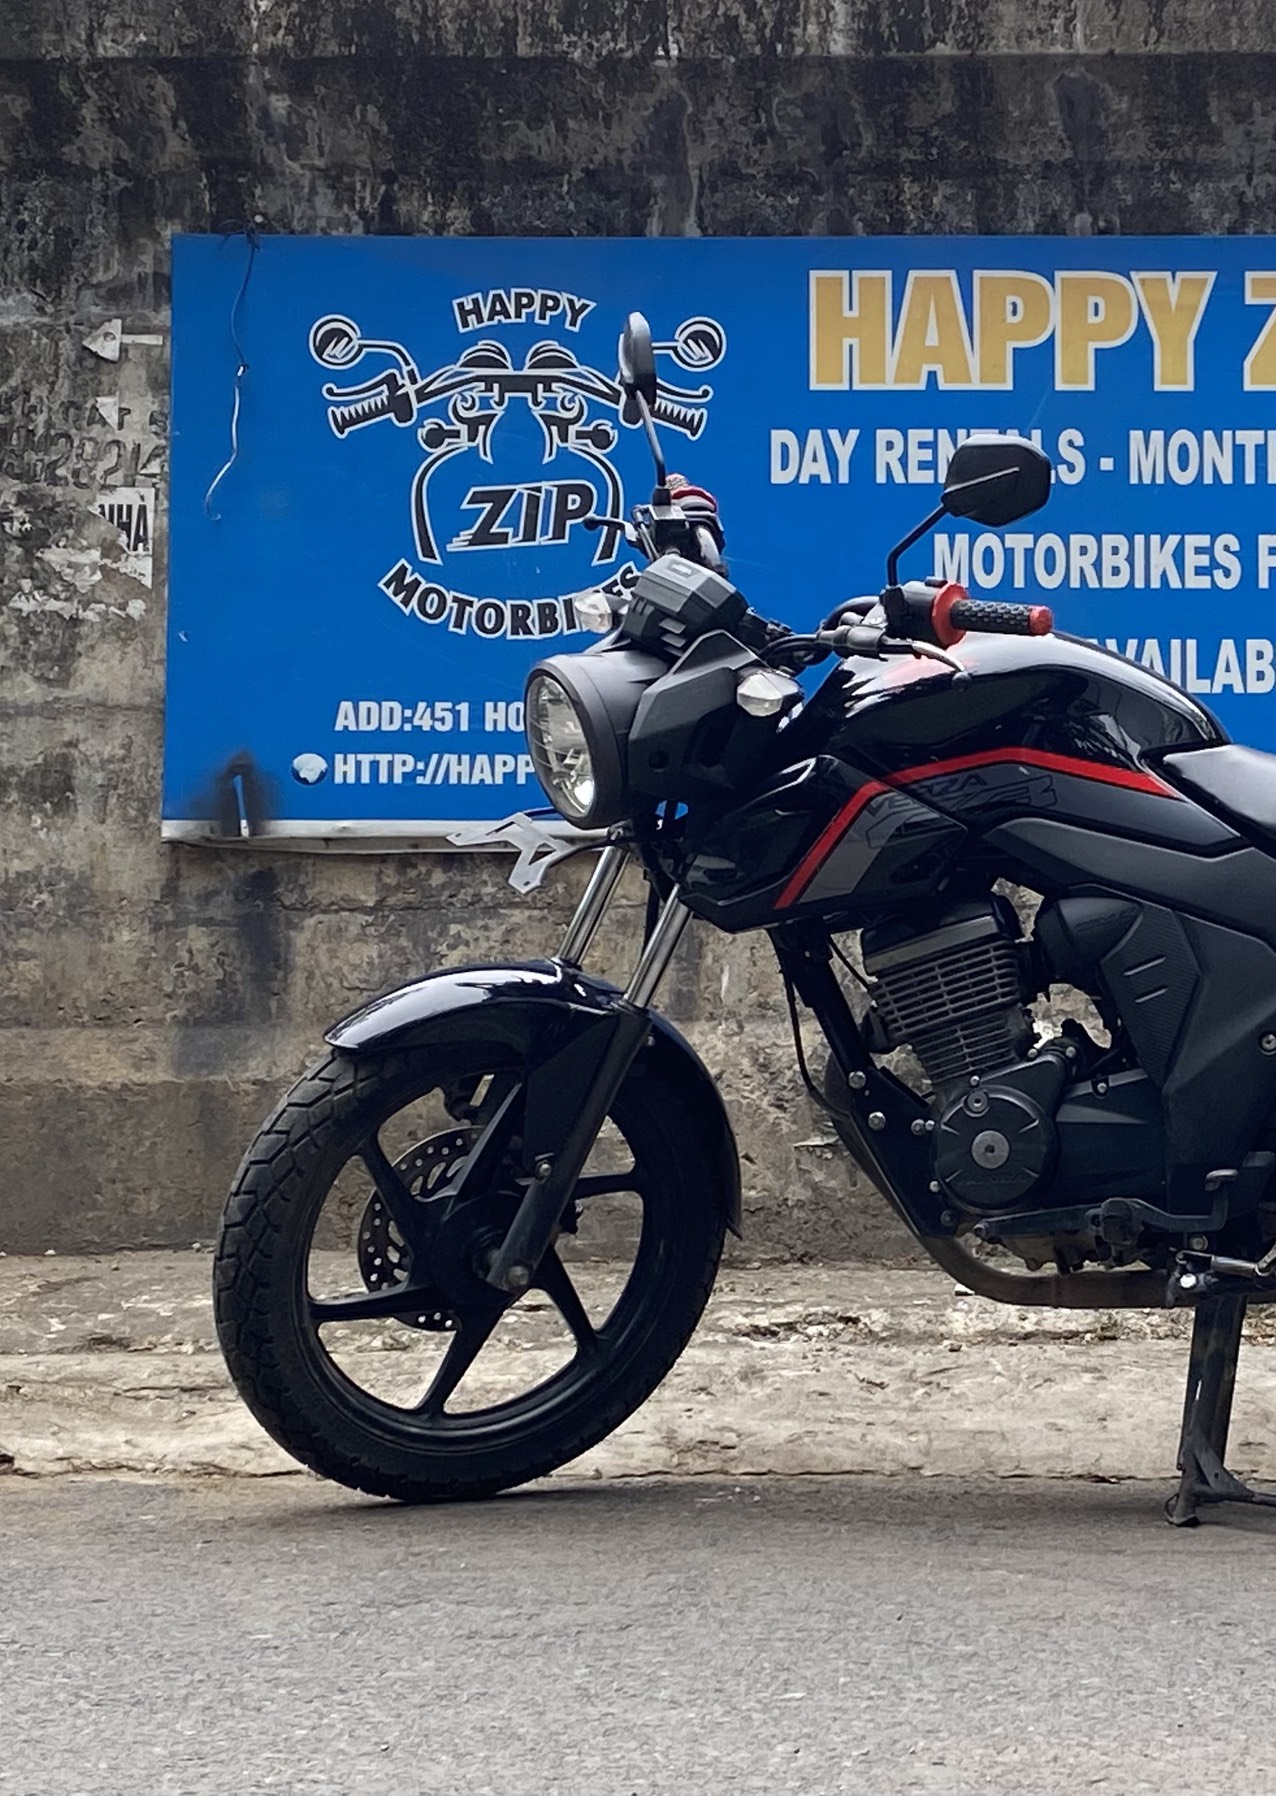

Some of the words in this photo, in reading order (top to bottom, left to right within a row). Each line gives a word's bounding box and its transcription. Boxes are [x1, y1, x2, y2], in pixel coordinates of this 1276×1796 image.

[452, 287, 597, 334] HAPPY
[809, 269, 1218, 392] HAPPY
[770, 429, 860, 484] DAY
[875, 428, 1086, 485] RENS
[1099, 457, 1114, 471] -
[447, 480, 598, 552] ZIP
[934, 532, 1242, 590] MOTORBIKES
[378, 558, 642, 640] MOTORBIES
[334, 700, 469, 732] ADD:451
